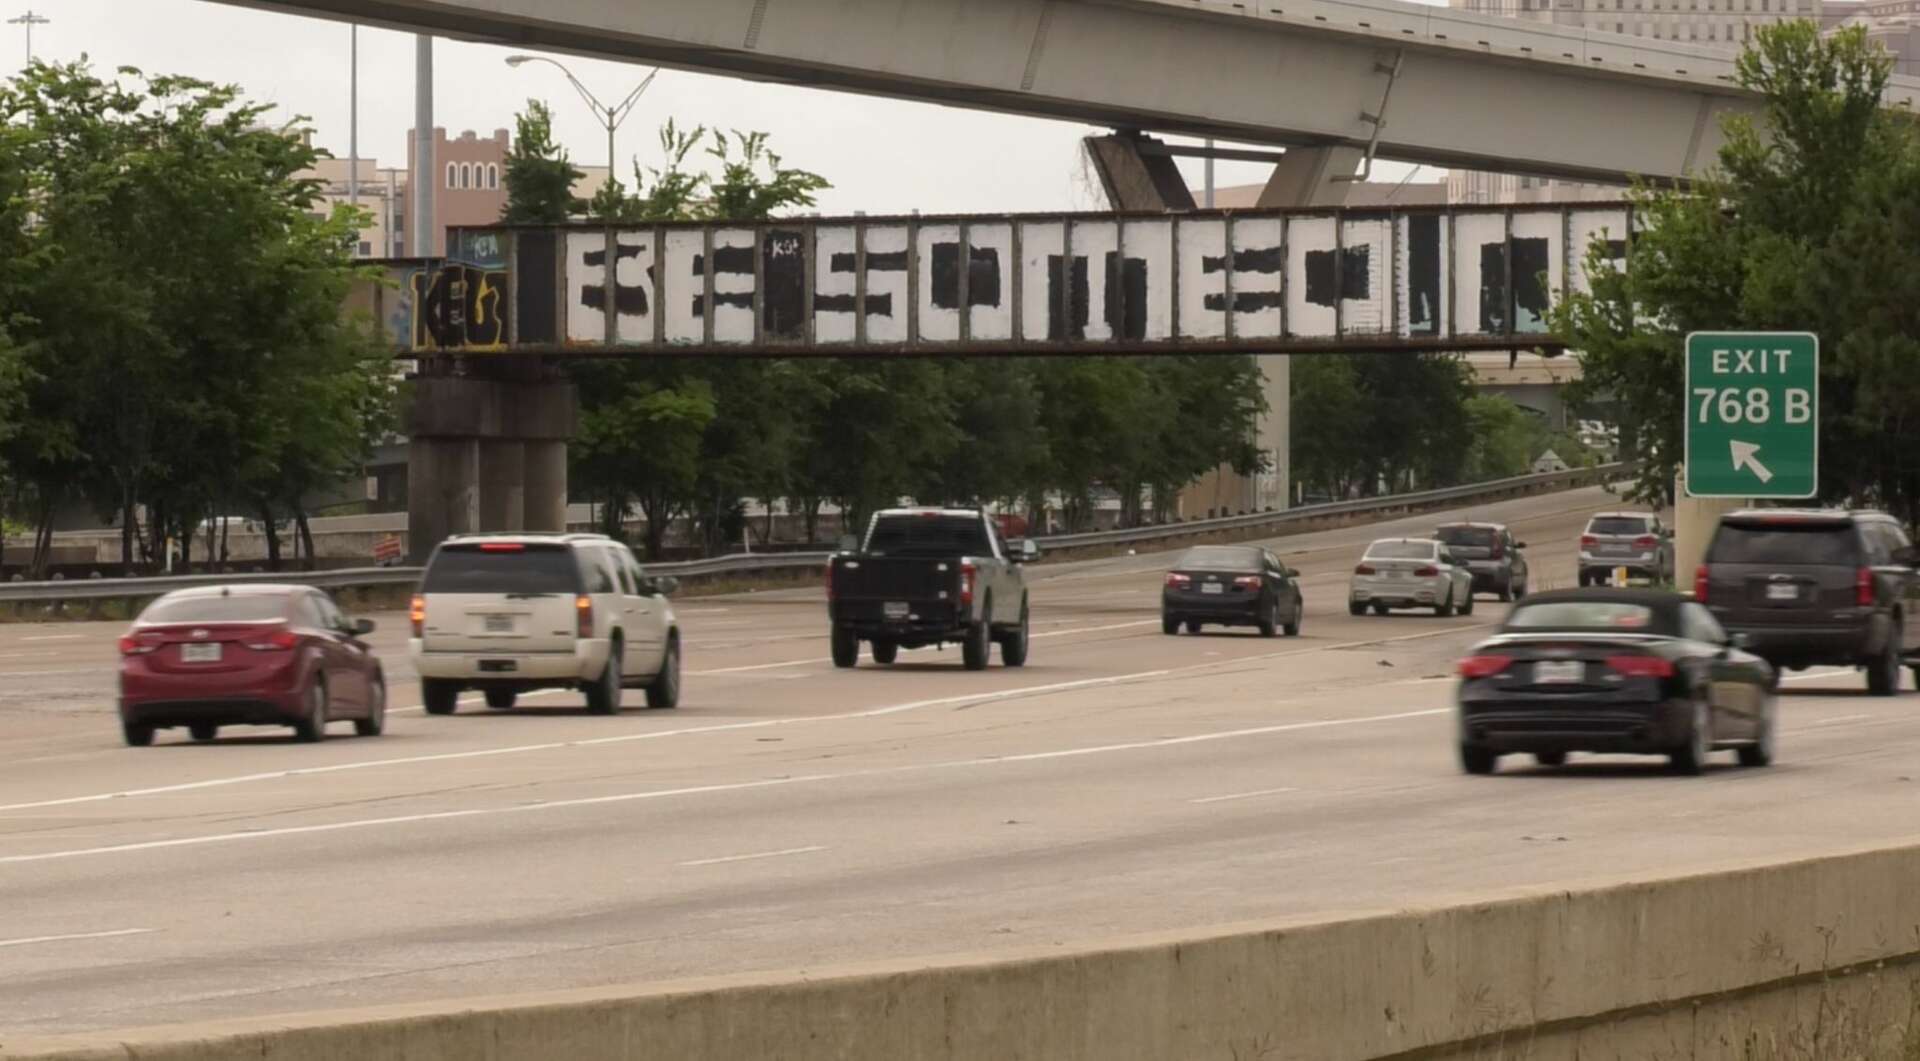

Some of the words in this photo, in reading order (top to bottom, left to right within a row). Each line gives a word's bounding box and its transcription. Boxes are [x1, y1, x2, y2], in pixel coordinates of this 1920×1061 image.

[566, 228, 756, 346] BE
[1712, 349, 1792, 374] EXIT
[1693, 387, 1770, 424] 768
[1784, 388, 1811, 424] B
